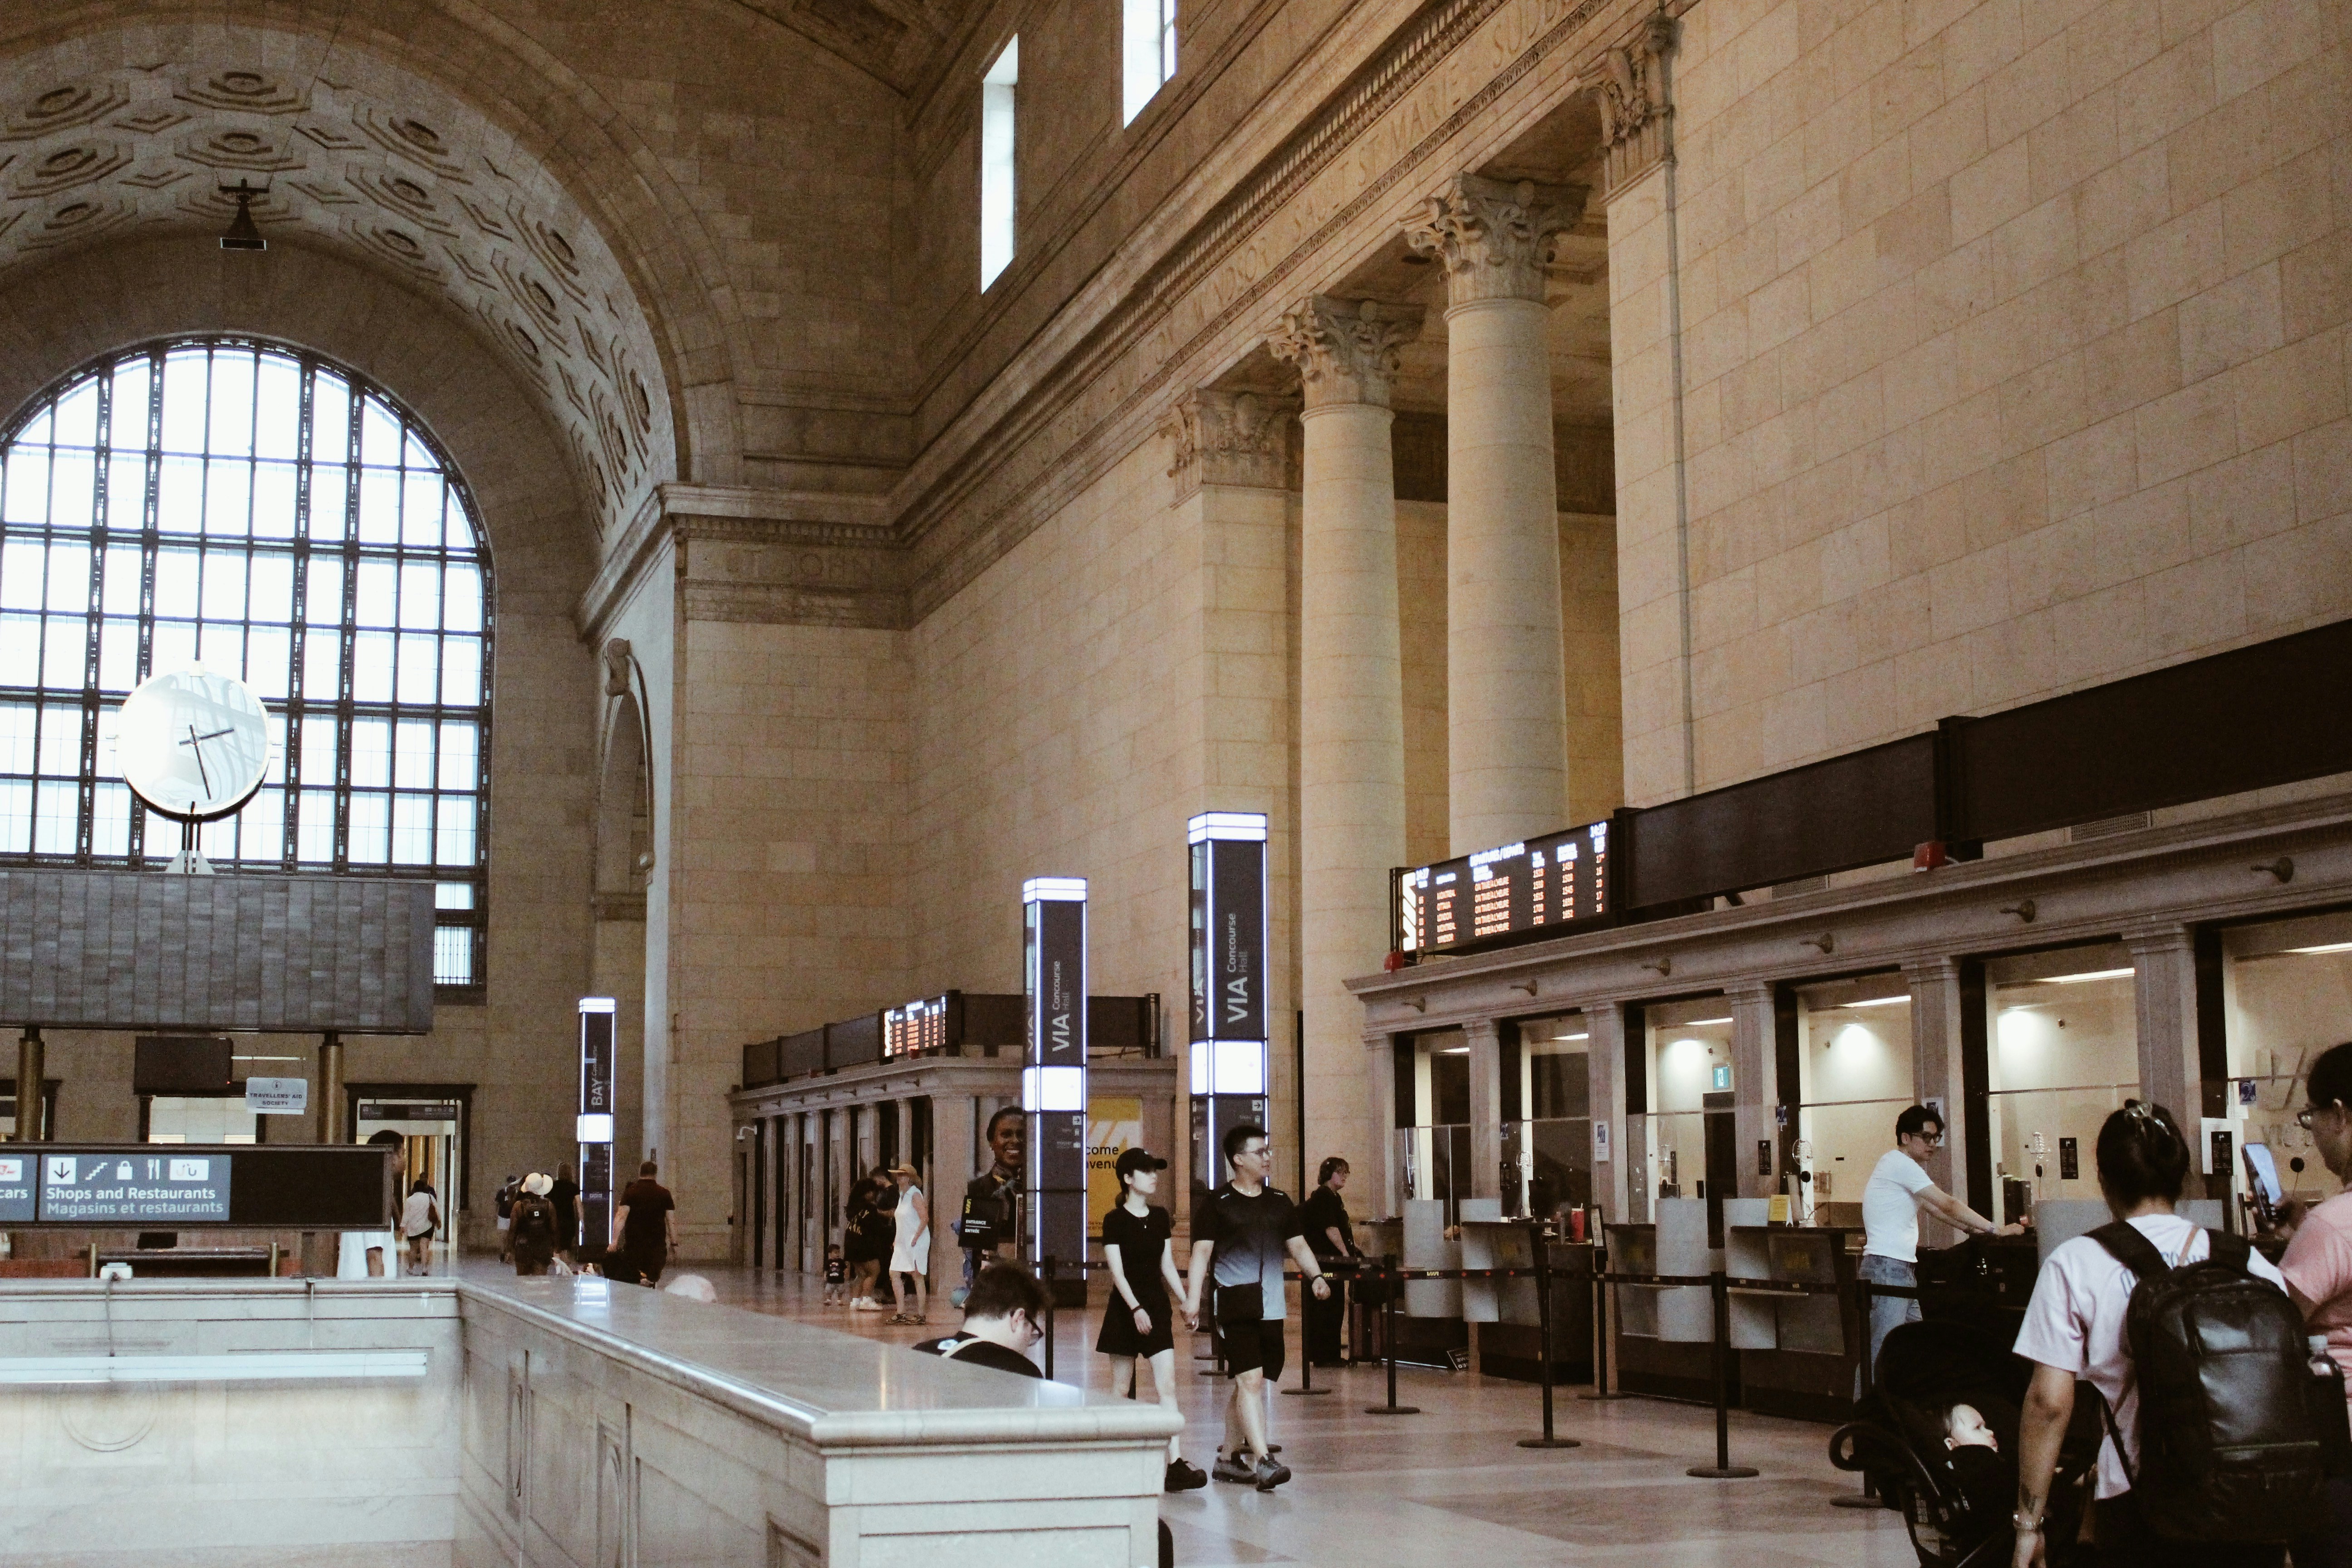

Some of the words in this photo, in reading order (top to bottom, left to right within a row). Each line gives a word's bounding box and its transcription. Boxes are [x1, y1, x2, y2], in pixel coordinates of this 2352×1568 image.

[1227, 912, 1237, 973] Concourse
[1052, 960, 1061, 1010] Concourse
[1227, 976, 1248, 1023] VIA
[1052, 1013, 1070, 1052] VIA
[591, 1078, 603, 1106] BAY
[1087, 1160, 1117, 1169] venu
[0, 1189, 28, 1199] cars
[47, 1187, 92, 1202] Shops
[96, 1187, 124, 1199] and
[127, 1187, 216, 1199] Restaurants
[47, 1203, 116, 1217] Magasins
[121, 1203, 136, 1214] et
[140, 1201, 224, 1213] restaurants
